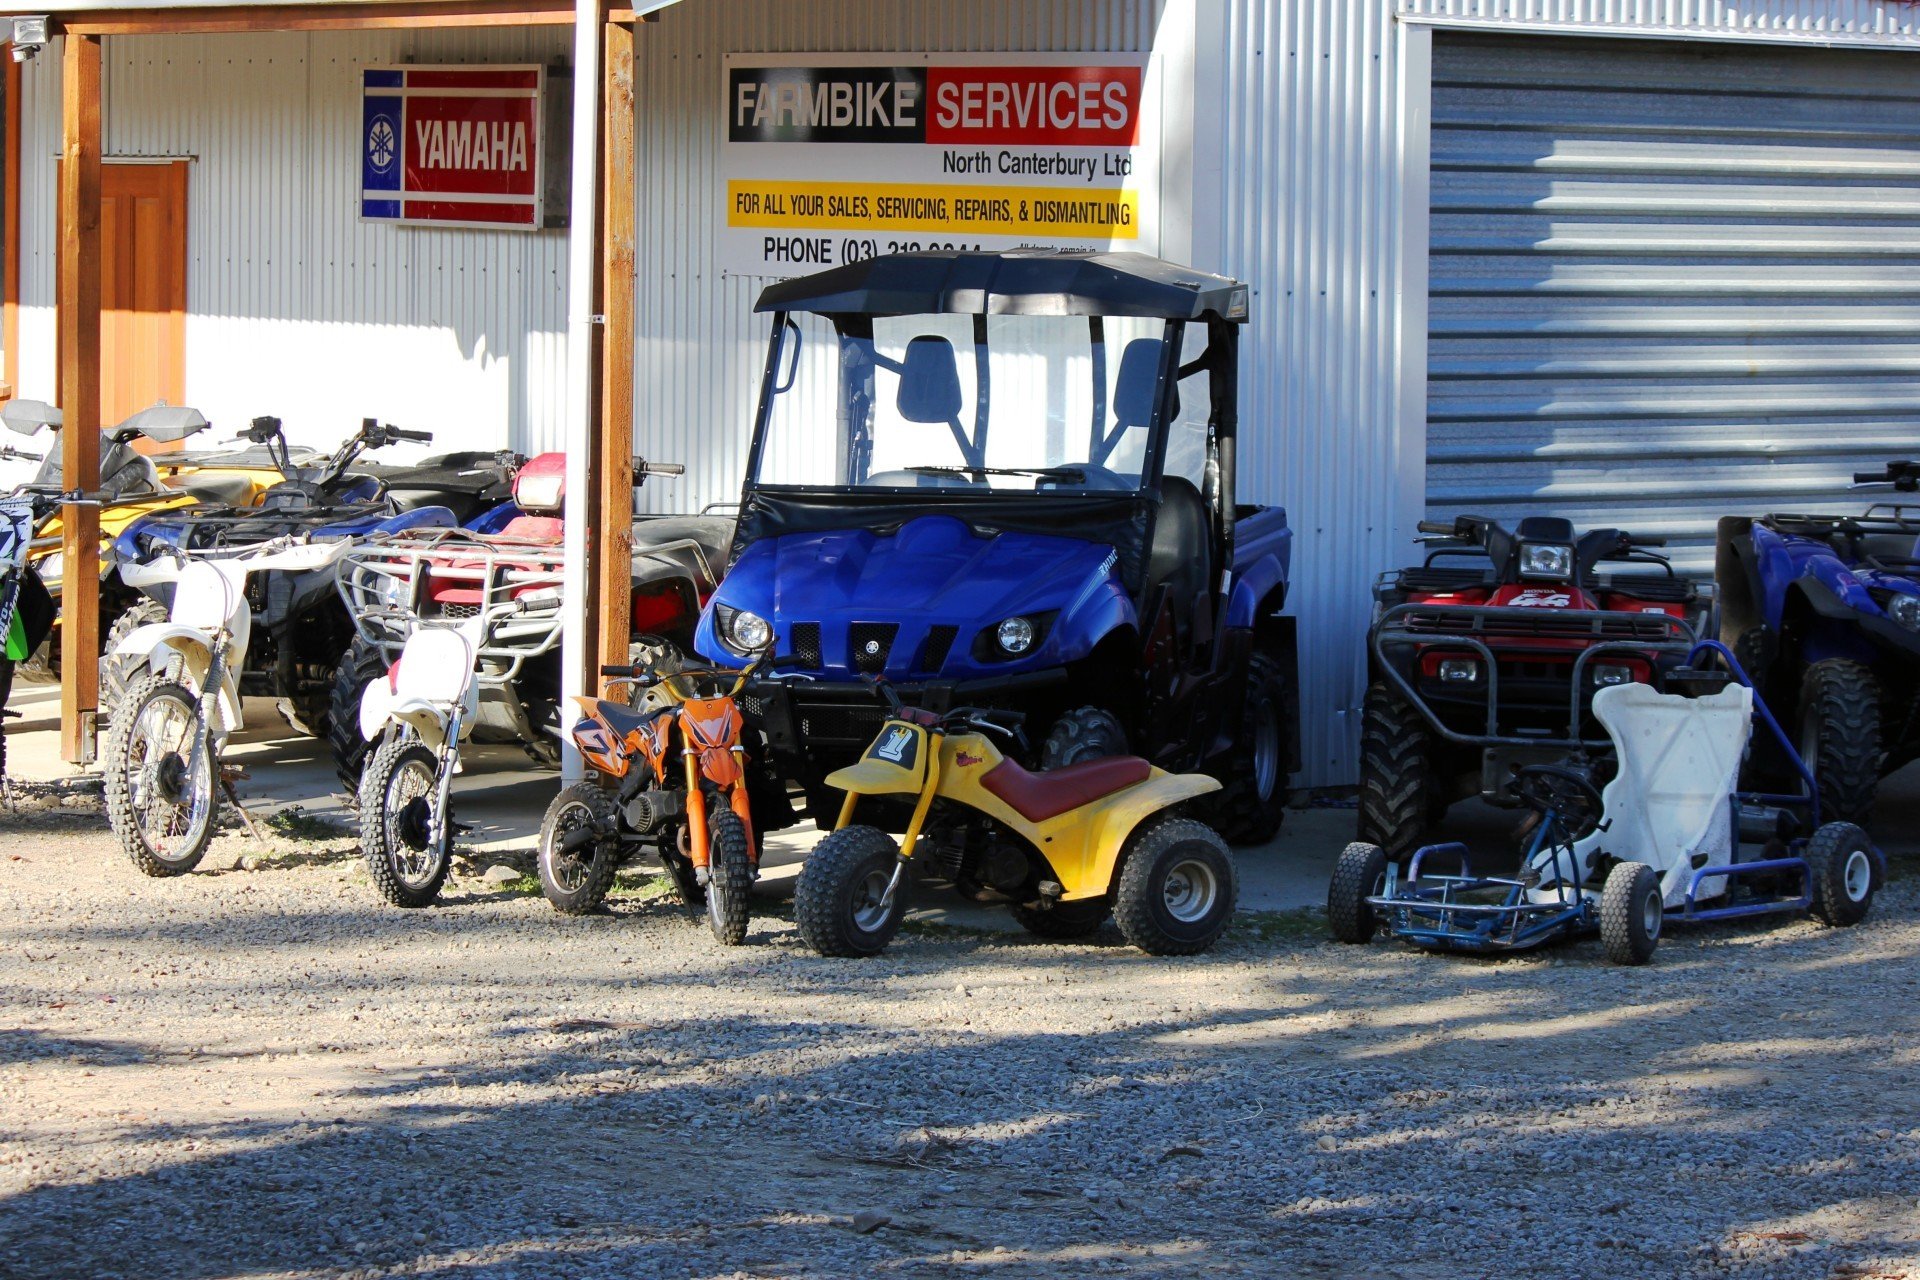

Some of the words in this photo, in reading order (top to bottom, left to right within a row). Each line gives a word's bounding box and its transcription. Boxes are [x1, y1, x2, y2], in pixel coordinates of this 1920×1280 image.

[737, 81, 916, 127] FARMBIKE
[936, 81, 1129, 130] SERVICES
[415, 119, 528, 172] YAMAHA
[943, 150, 991, 174] North
[998, 150, 1097, 182] Canterbury
[1104, 152, 1132, 176] Ltd
[736, 192, 760, 214] FOR
[763, 193, 786, 215] ALL
[790, 194, 824, 216] YOUR
[828, 195, 872, 221] SALES,
[876, 196, 950, 224] SERVICING,
[955, 199, 1014, 225] REPAIRS,
[1018, 201, 1029, 222] &
[1034, 201, 1130, 226] DISMANTLING
[764, 236, 832, 264] PHONE
[841, 237, 878, 266] (03)
